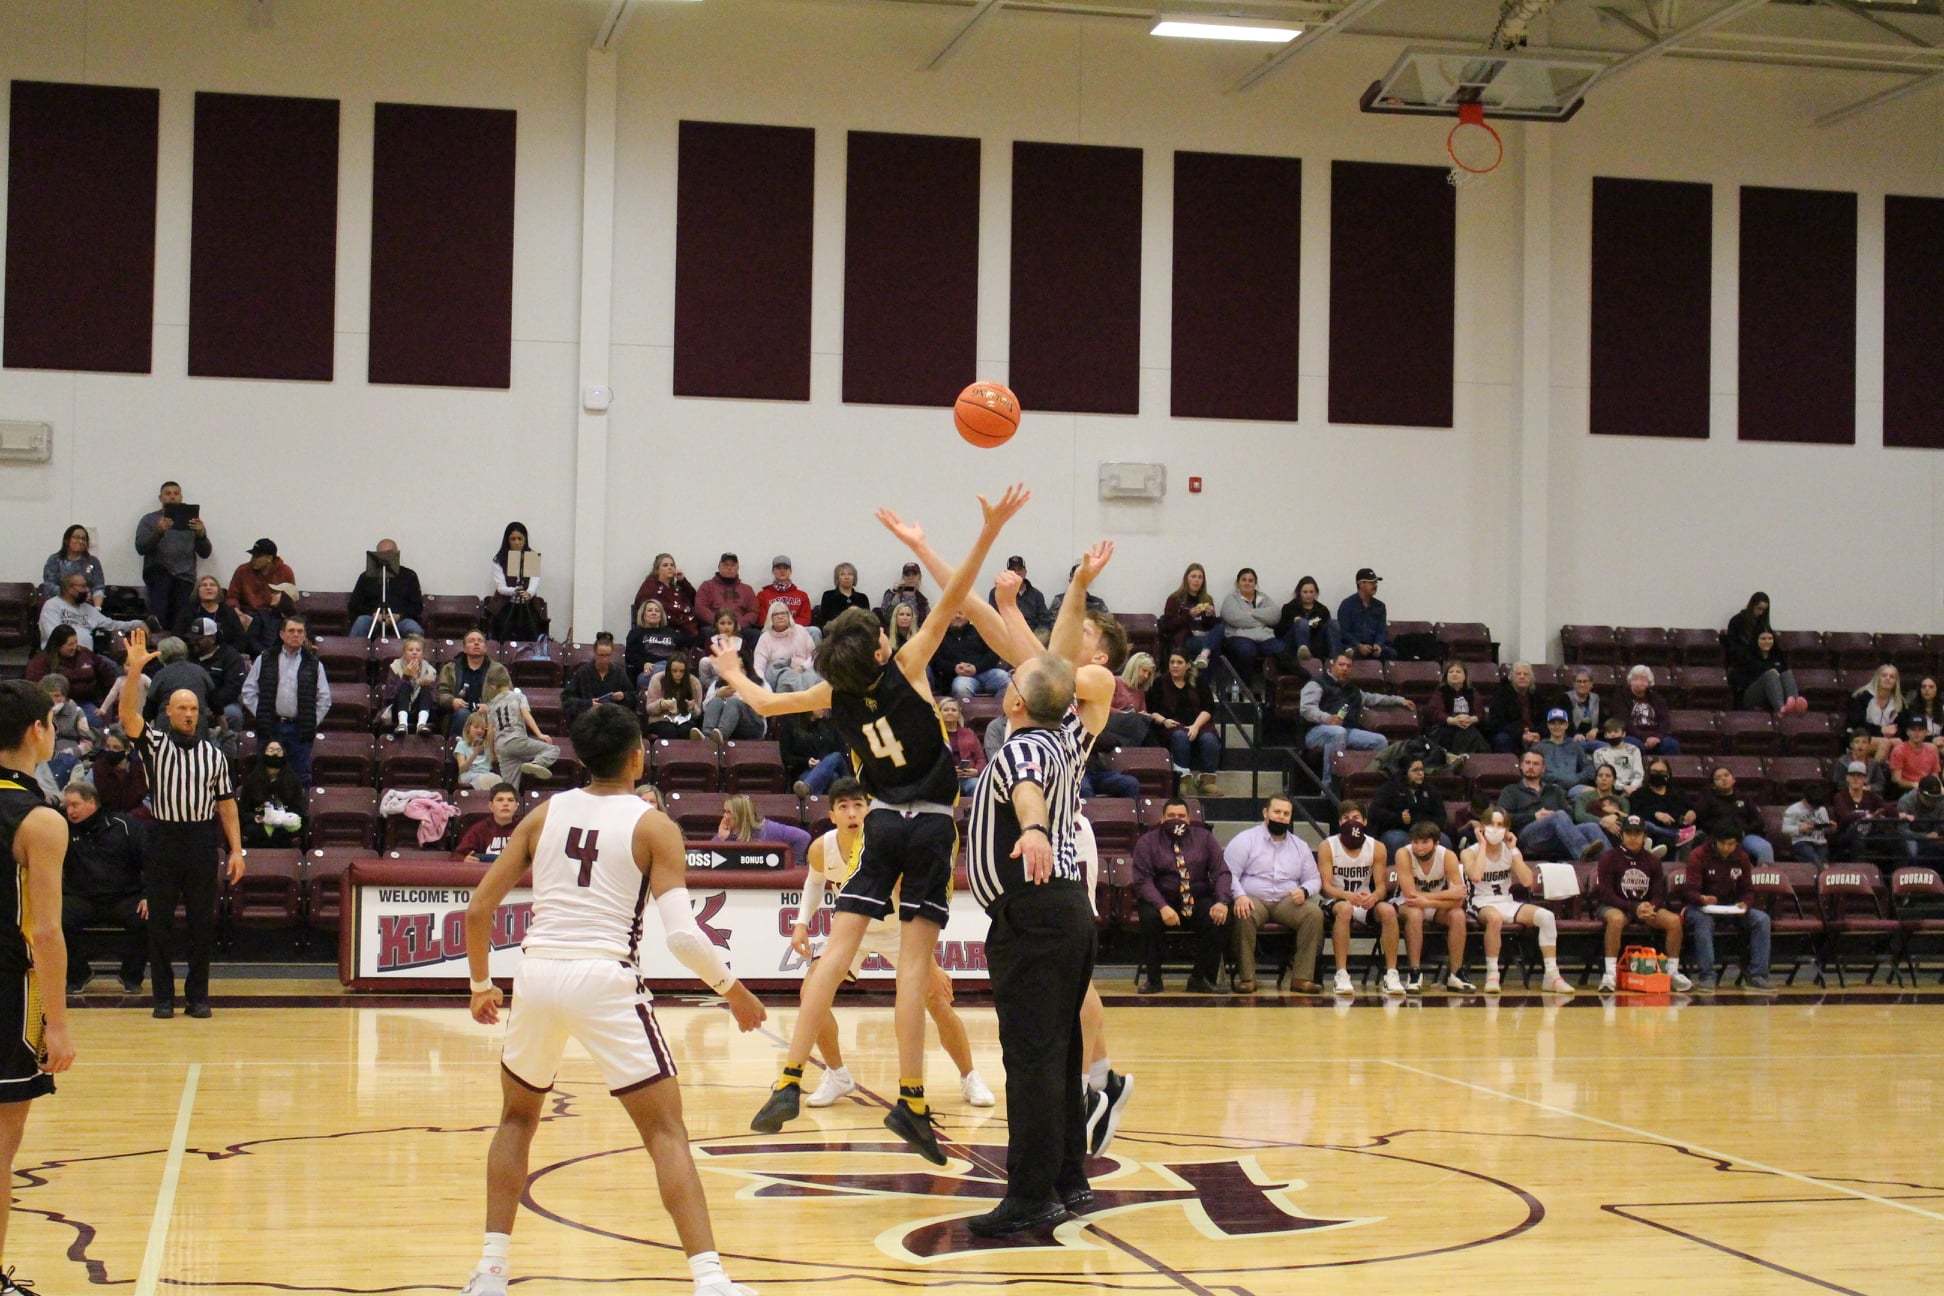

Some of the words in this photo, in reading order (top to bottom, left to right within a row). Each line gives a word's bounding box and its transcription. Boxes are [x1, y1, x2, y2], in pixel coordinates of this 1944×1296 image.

[496, 705, 512, 731] 11
[862, 715, 907, 768] 4
[564, 827, 599, 888] 4
[685, 853, 711, 867] OSS
[740, 855, 764, 865] BONUS
[1751, 873, 1780, 885] OUGARS
[1826, 873, 1861, 886] COUGARS
[1900, 872, 1934, 886] COUGARS
[379, 889, 449, 904] WELCOME
[453, 889, 471, 904] TO
[377, 901, 535, 973] KLOND
